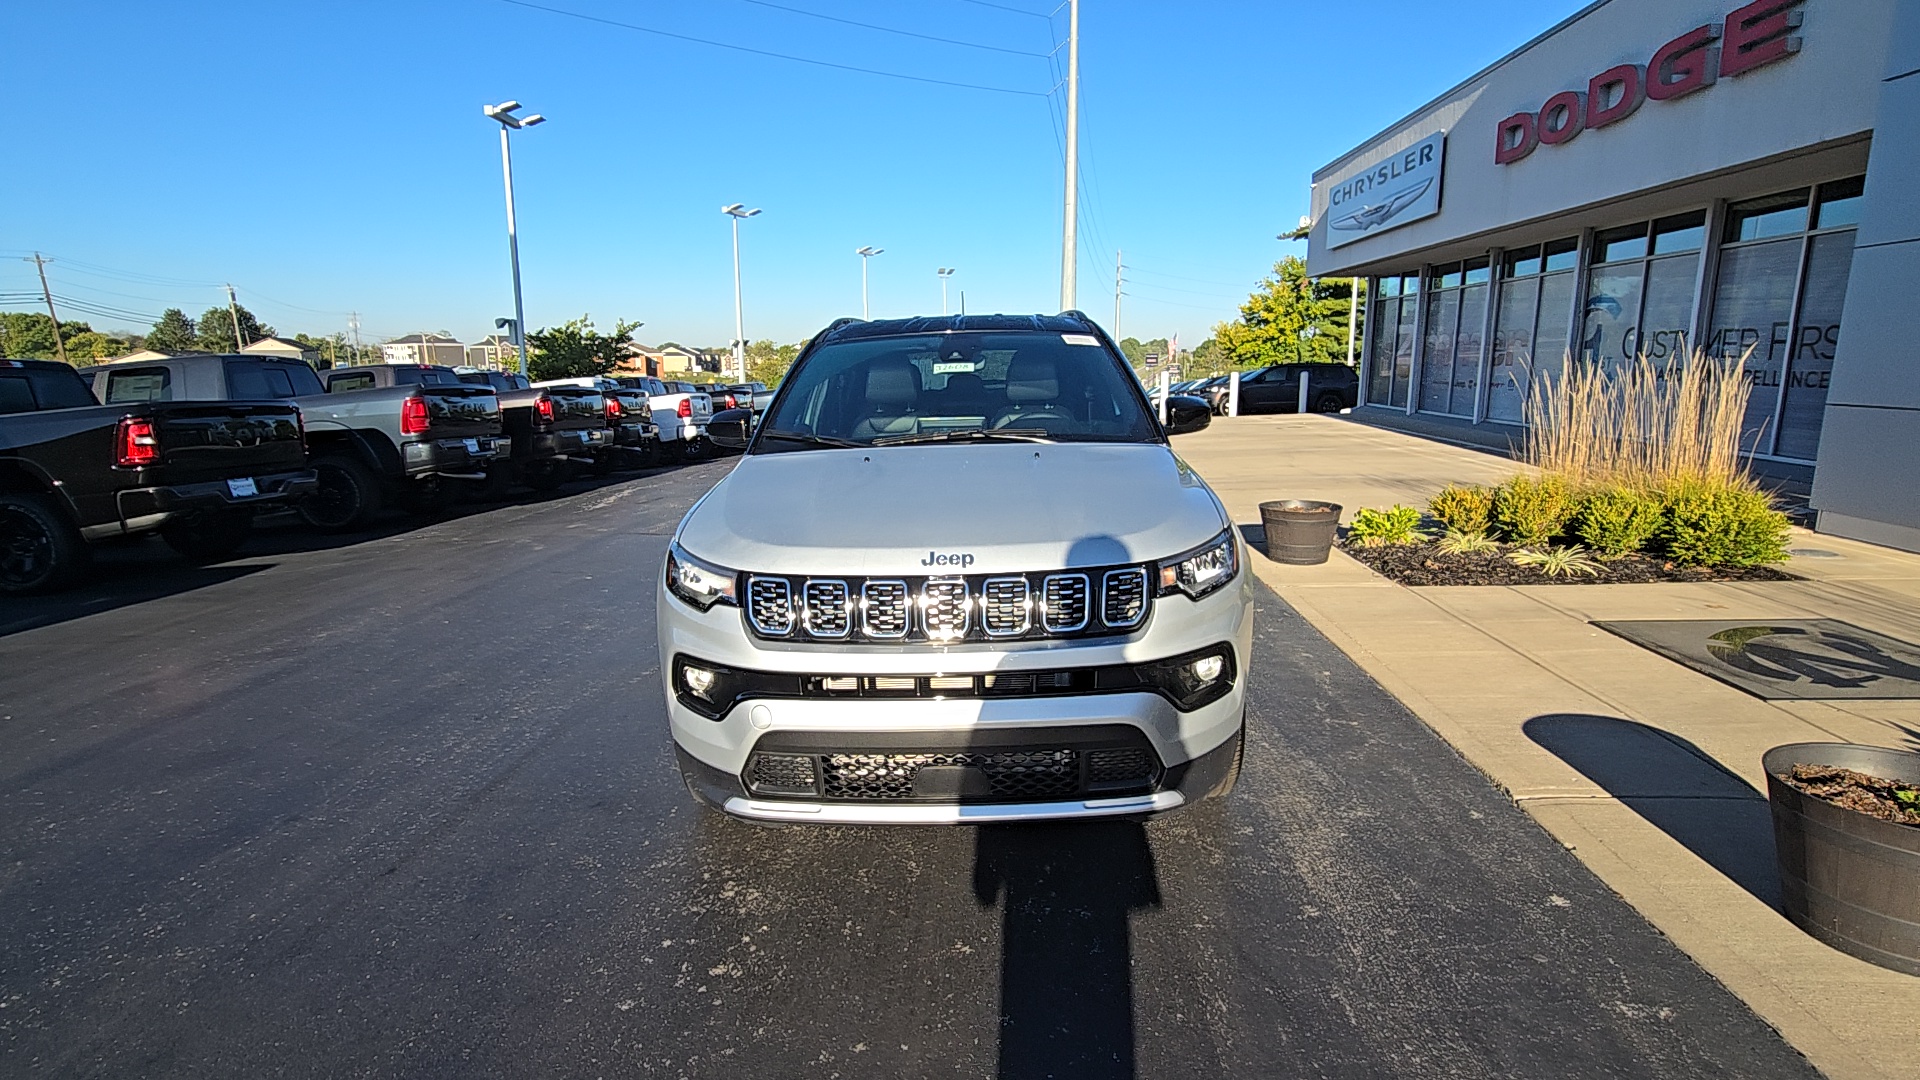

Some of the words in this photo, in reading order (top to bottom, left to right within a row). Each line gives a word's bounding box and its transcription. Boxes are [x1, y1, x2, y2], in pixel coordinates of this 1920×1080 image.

[1494, 0, 1802, 165] DODGE
[1332, 143, 1434, 206] CHRYSLER
[1622, 326, 1760, 360] CUSTMER
[449, 402, 487, 413] RAM
[208, 427, 273, 443] RAM
[921, 551, 975, 569] Jeep
